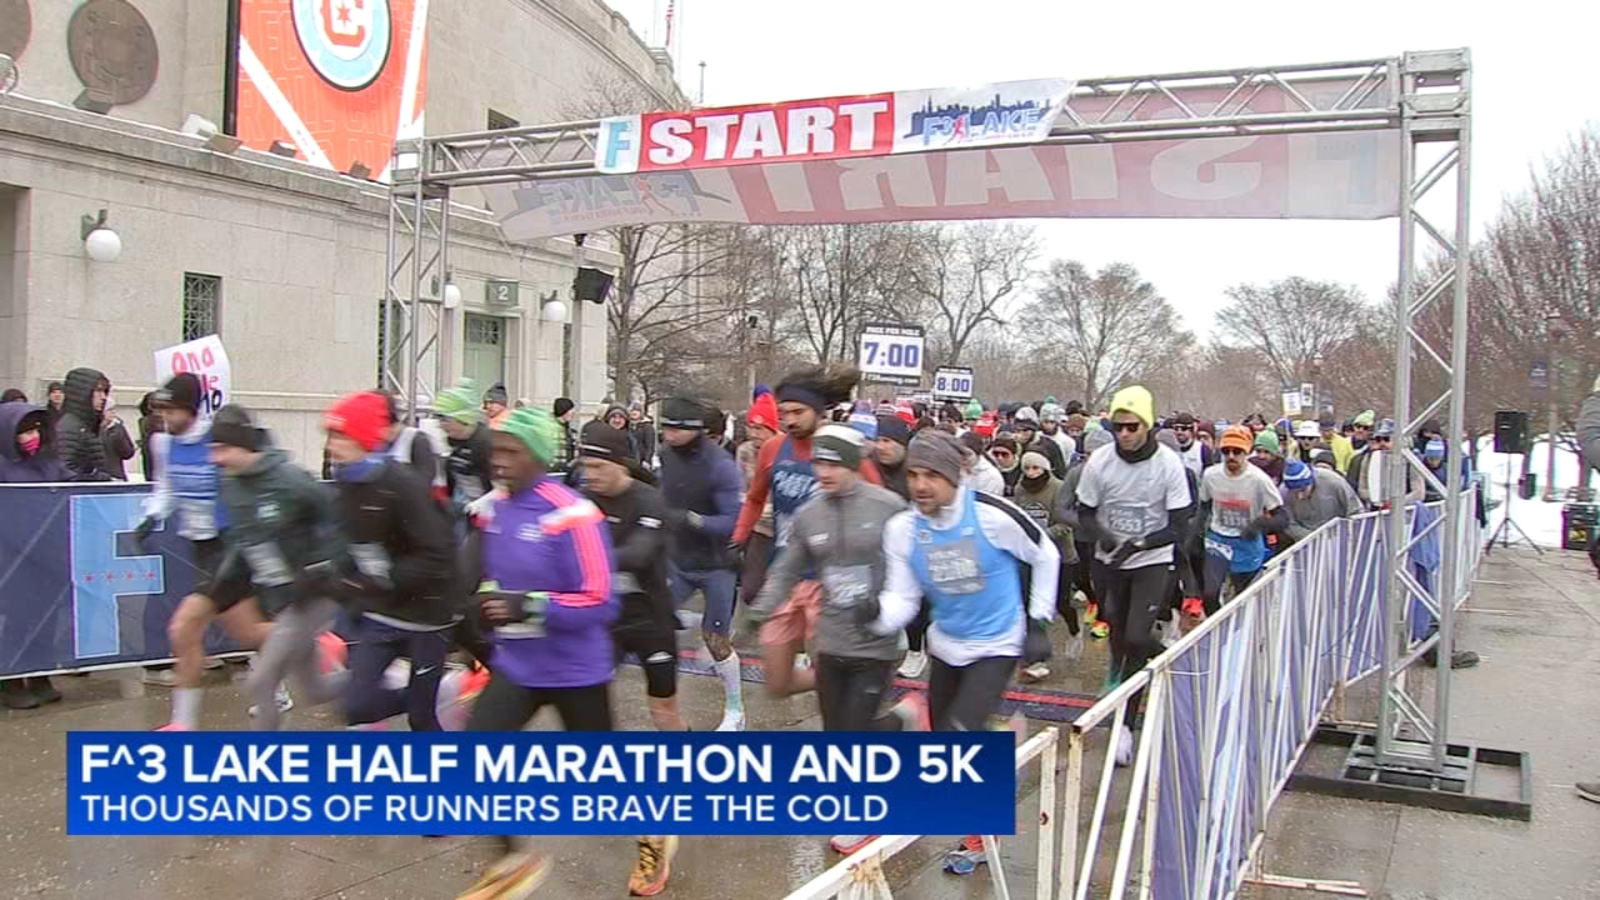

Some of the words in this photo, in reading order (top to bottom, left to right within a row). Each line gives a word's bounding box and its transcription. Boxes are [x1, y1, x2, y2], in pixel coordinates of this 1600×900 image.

[604, 120, 630, 169] F
[649, 100, 889, 165] START
[498, 285, 509, 301] 2
[863, 341, 920, 368] 7:00
[937, 376, 971, 393] 8:00
[69, 493, 165, 659] F
